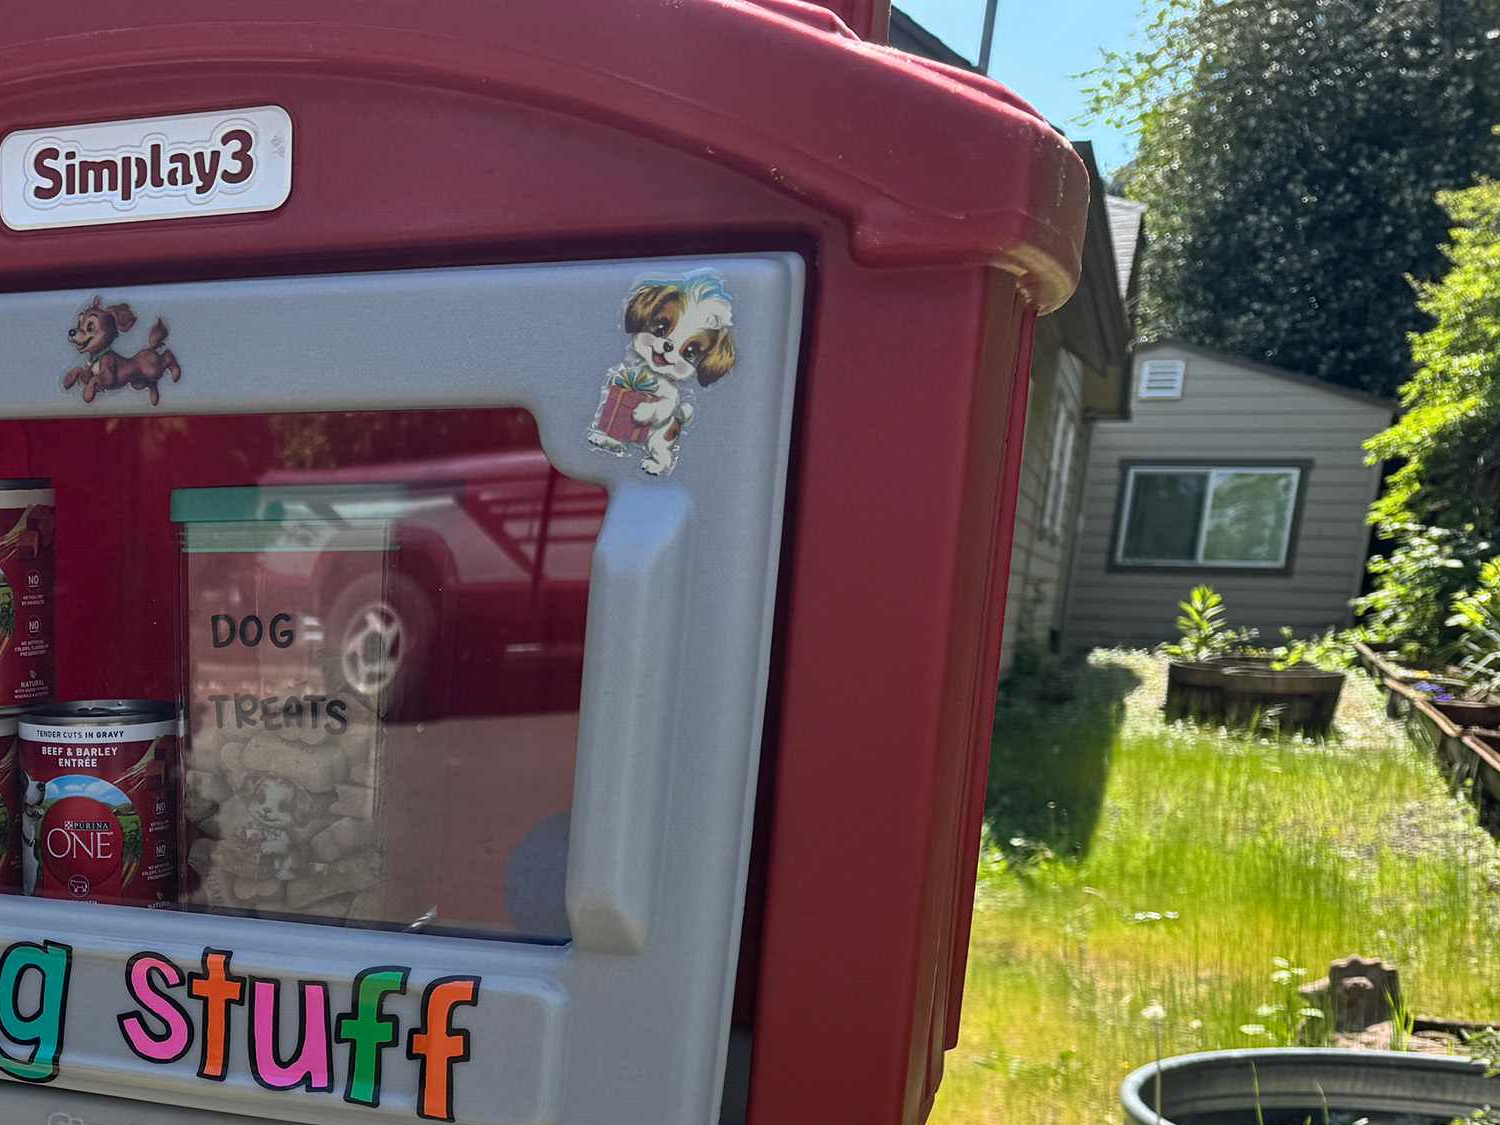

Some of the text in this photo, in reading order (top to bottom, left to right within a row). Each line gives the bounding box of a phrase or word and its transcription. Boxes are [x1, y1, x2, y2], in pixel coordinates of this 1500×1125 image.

[33, 129, 254, 201] Simplay3
[211, 613, 295, 649] DOG
[208, 692, 349, 735] TREATS
[36, 729, 125, 739] TENDER CUTS IN GRAVY
[41, 746, 118, 757] BEEF & BARLEY
[58, 756, 98, 768] ENTRÉE
[73, 822, 110, 830] PURINA
[47, 827, 114, 859] ONE
[116, 946, 483, 1124] stuff
